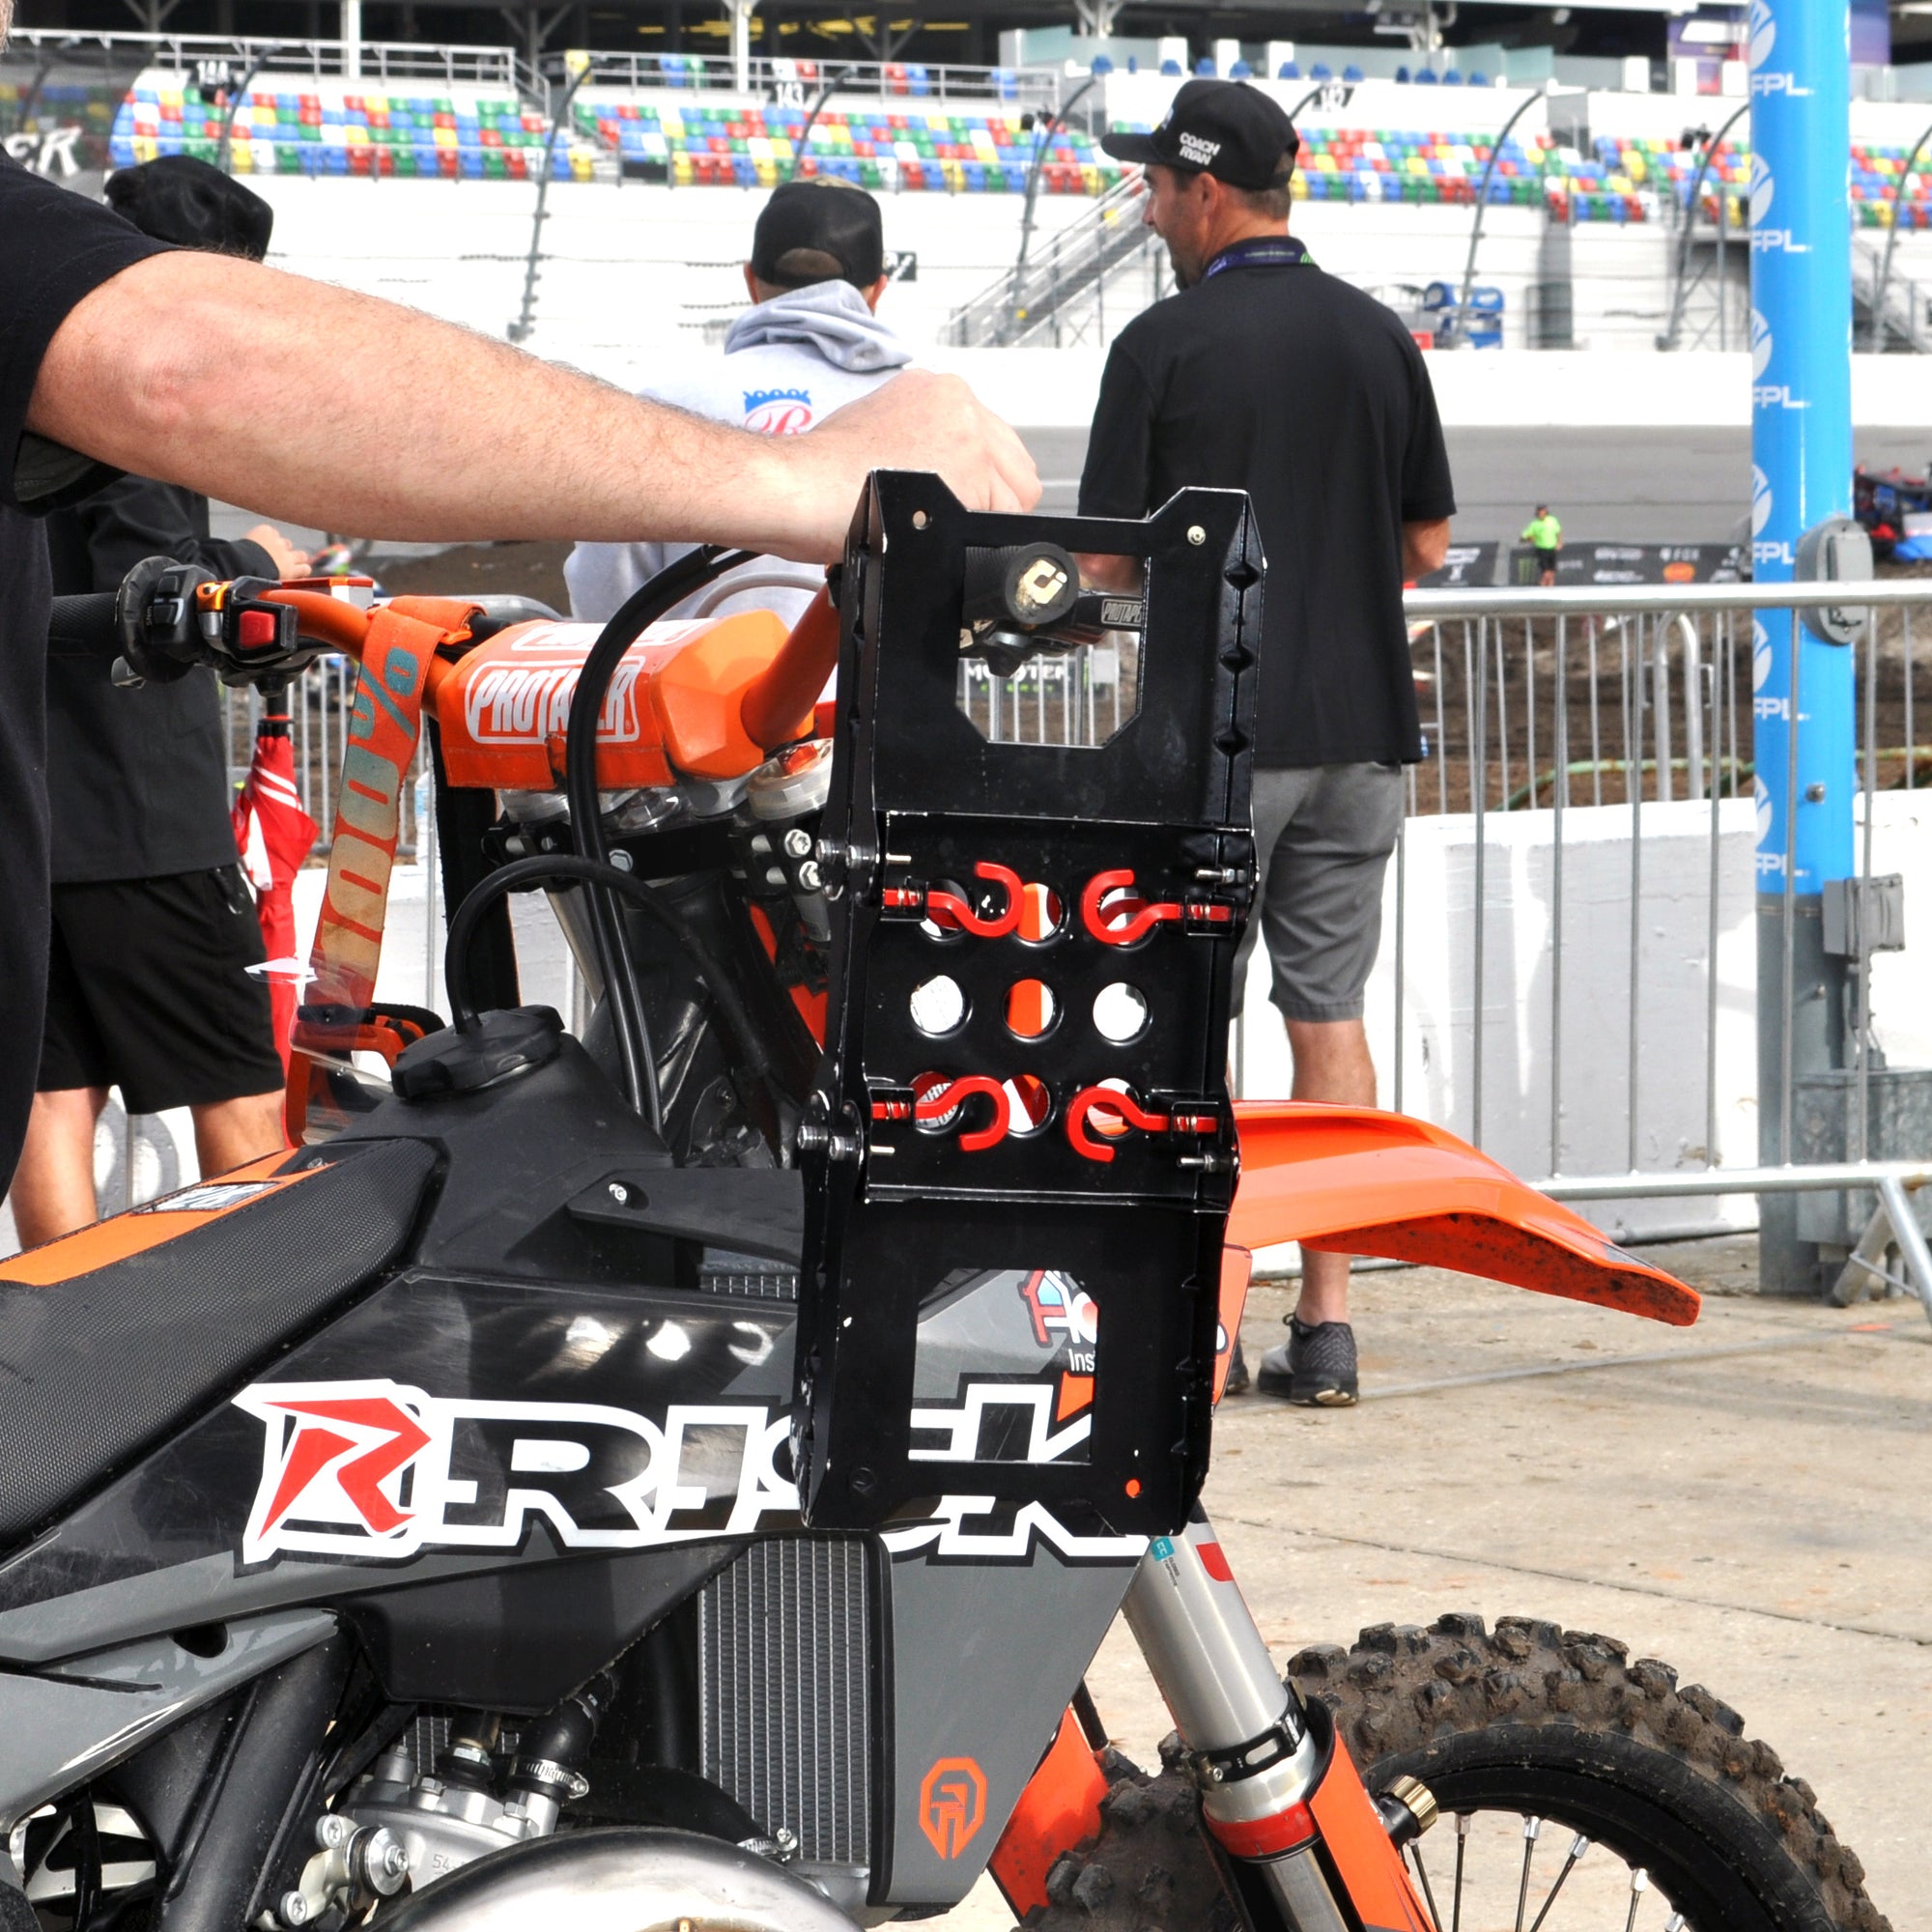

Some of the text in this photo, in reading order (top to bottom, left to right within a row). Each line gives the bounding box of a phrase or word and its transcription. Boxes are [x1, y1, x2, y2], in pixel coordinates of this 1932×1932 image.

[1750, 72, 1809, 96] FPL
[1179, 131, 1221, 156] COACH
[1179, 145, 1212, 166] RYAN
[1750, 230, 1807, 252] FPL
[1752, 385, 1805, 409] FPL
[1752, 542, 1795, 564] FPL
[1103, 601, 1143, 624] PROTAPE
[468, 663, 639, 742] PROTAR
